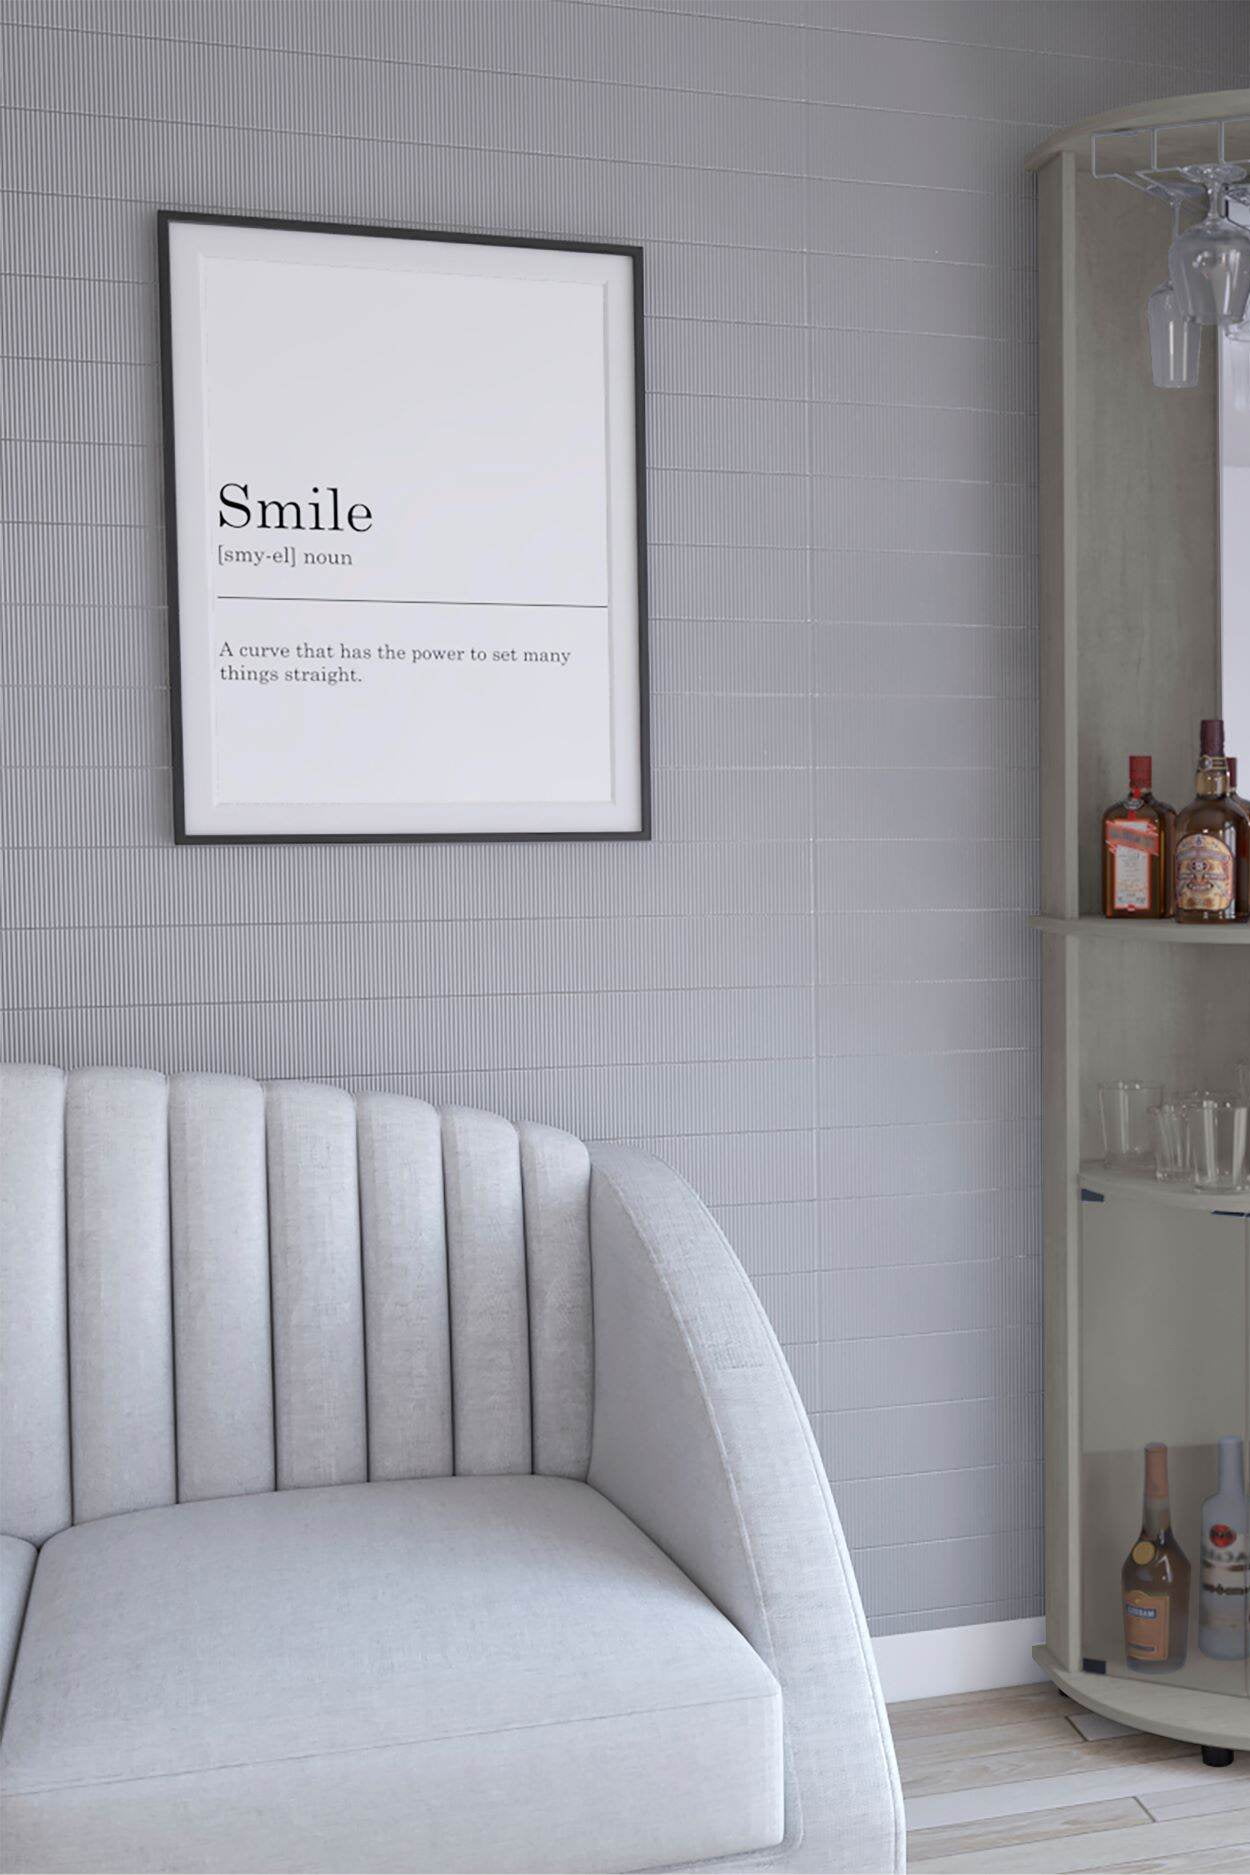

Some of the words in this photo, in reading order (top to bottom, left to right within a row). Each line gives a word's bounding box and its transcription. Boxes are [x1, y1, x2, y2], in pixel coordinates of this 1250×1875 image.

[218, 482, 373, 532] Smile
[217, 544, 296, 568] [smy-el]
[303, 552, 353, 566] noun
[219, 641, 234, 657] A
[239, 646, 290, 659] curve
[296, 642, 334, 659] that
[340, 643, 372, 660] has
[378, 643, 406, 661] the
[411, 648, 465, 664] power
[470, 647, 487, 661] to
[493, 648, 518, 662] set
[523, 650, 571, 666] many
[219, 665, 279, 685] things
[284, 666, 362, 686] straight.
